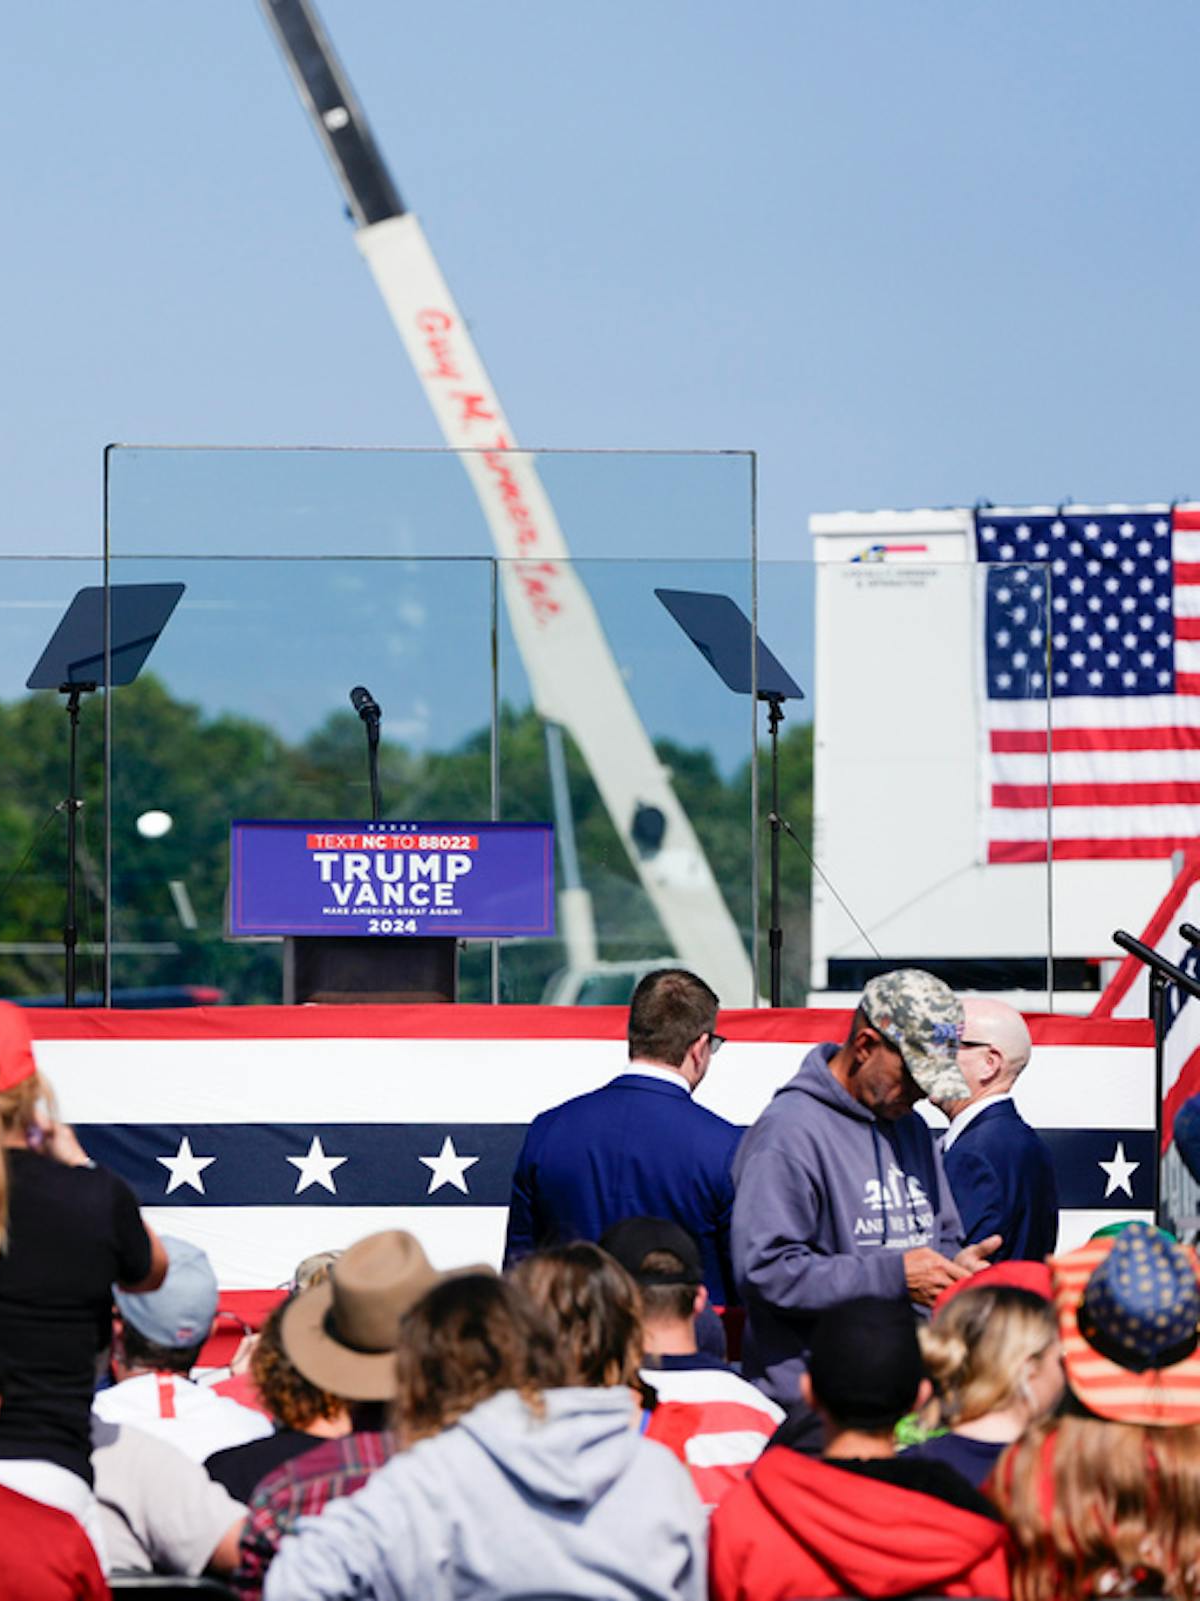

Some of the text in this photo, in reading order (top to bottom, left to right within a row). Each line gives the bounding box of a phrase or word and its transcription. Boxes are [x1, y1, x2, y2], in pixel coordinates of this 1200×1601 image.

[416, 308, 463, 380] Guy
[315, 834, 471, 850] TEXT NC TO 88022
[312, 853, 473, 883] TRUMP
[331, 882, 454, 907] VANCE
[351, 907, 395, 916] AMERICA
[367, 918, 418, 934] 2024
